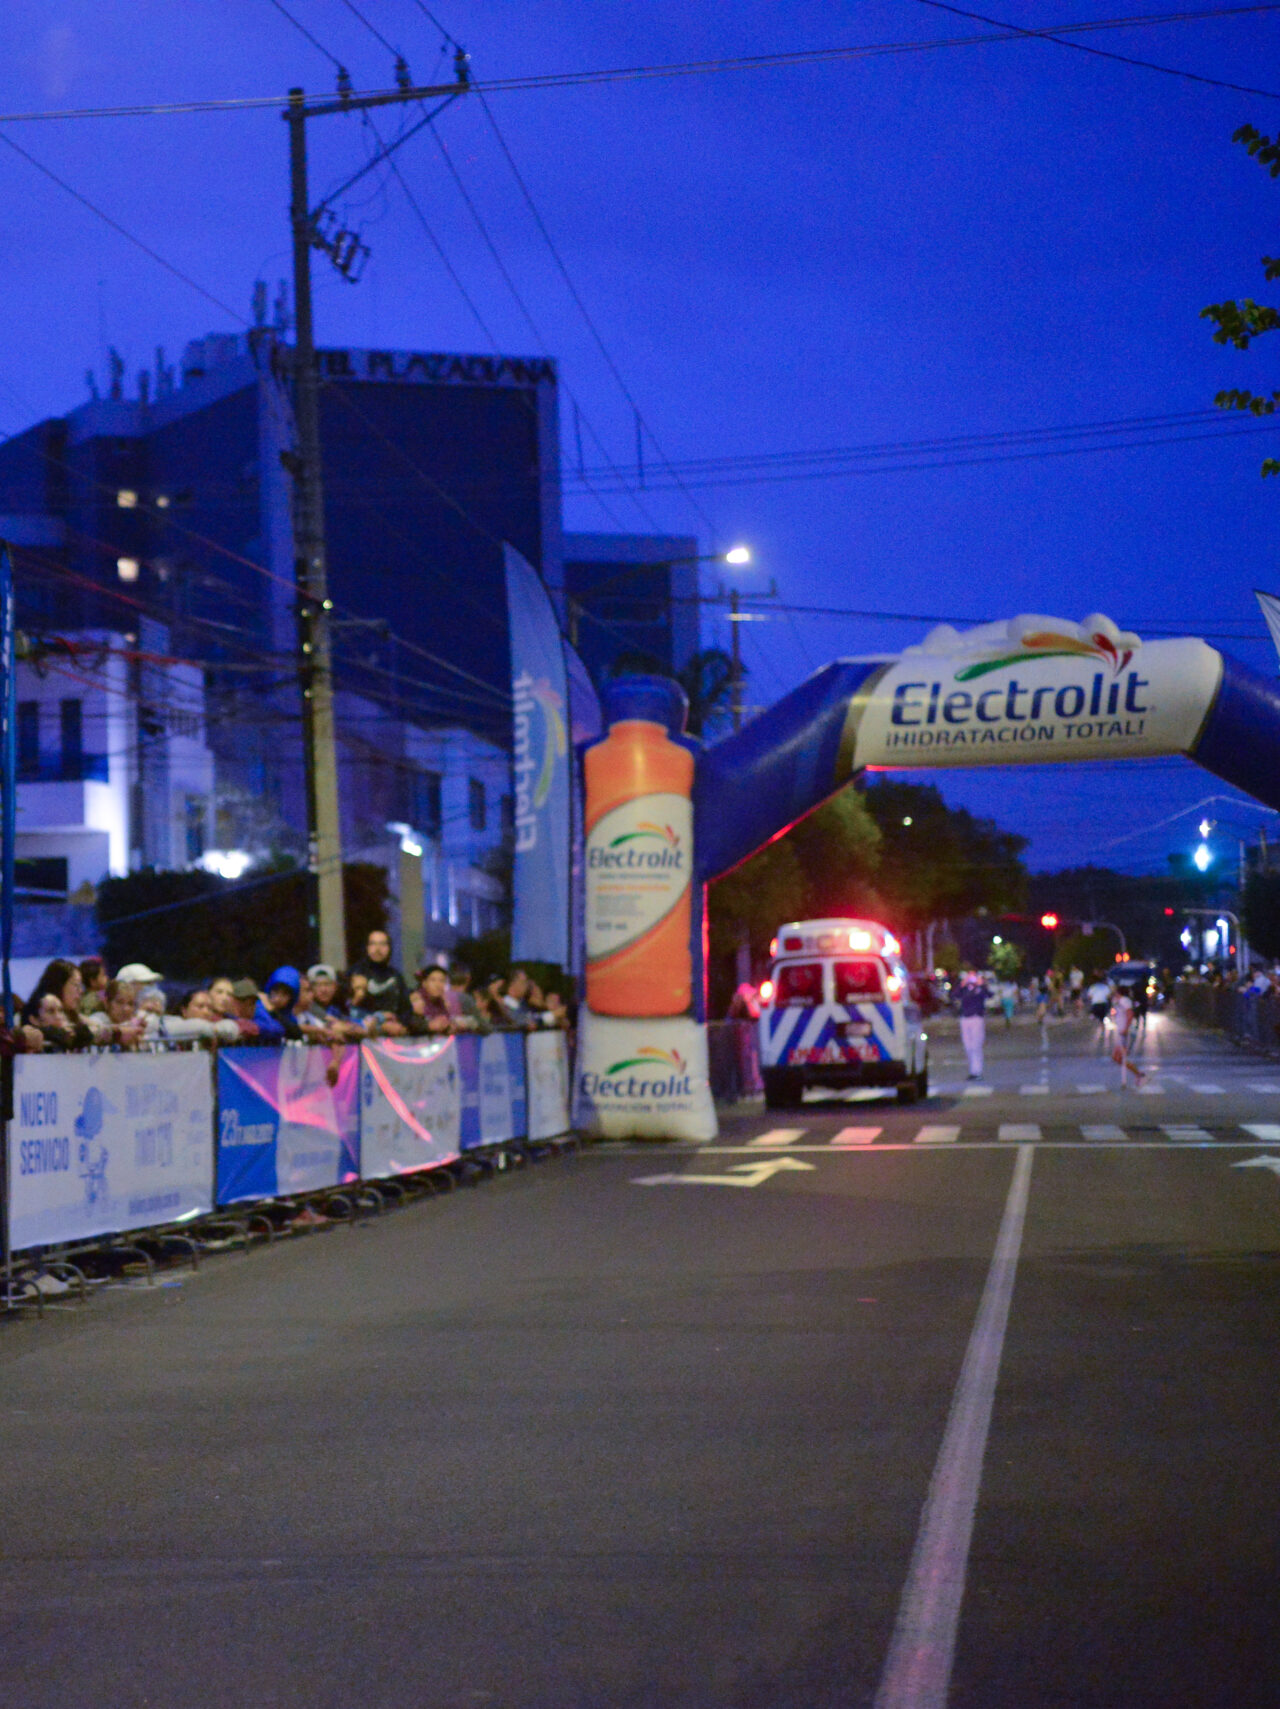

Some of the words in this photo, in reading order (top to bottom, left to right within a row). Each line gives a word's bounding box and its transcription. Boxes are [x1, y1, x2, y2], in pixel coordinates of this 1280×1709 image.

[890, 671, 1150, 727] Electrolit
[1063, 719, 1145, 741] TOTAL!
[588, 845, 683, 869] Electrolit
[579, 1072, 694, 1099] Electrolit
[20, 1091, 58, 1127] NUEVO
[20, 1137, 69, 1175] SERVICIO
